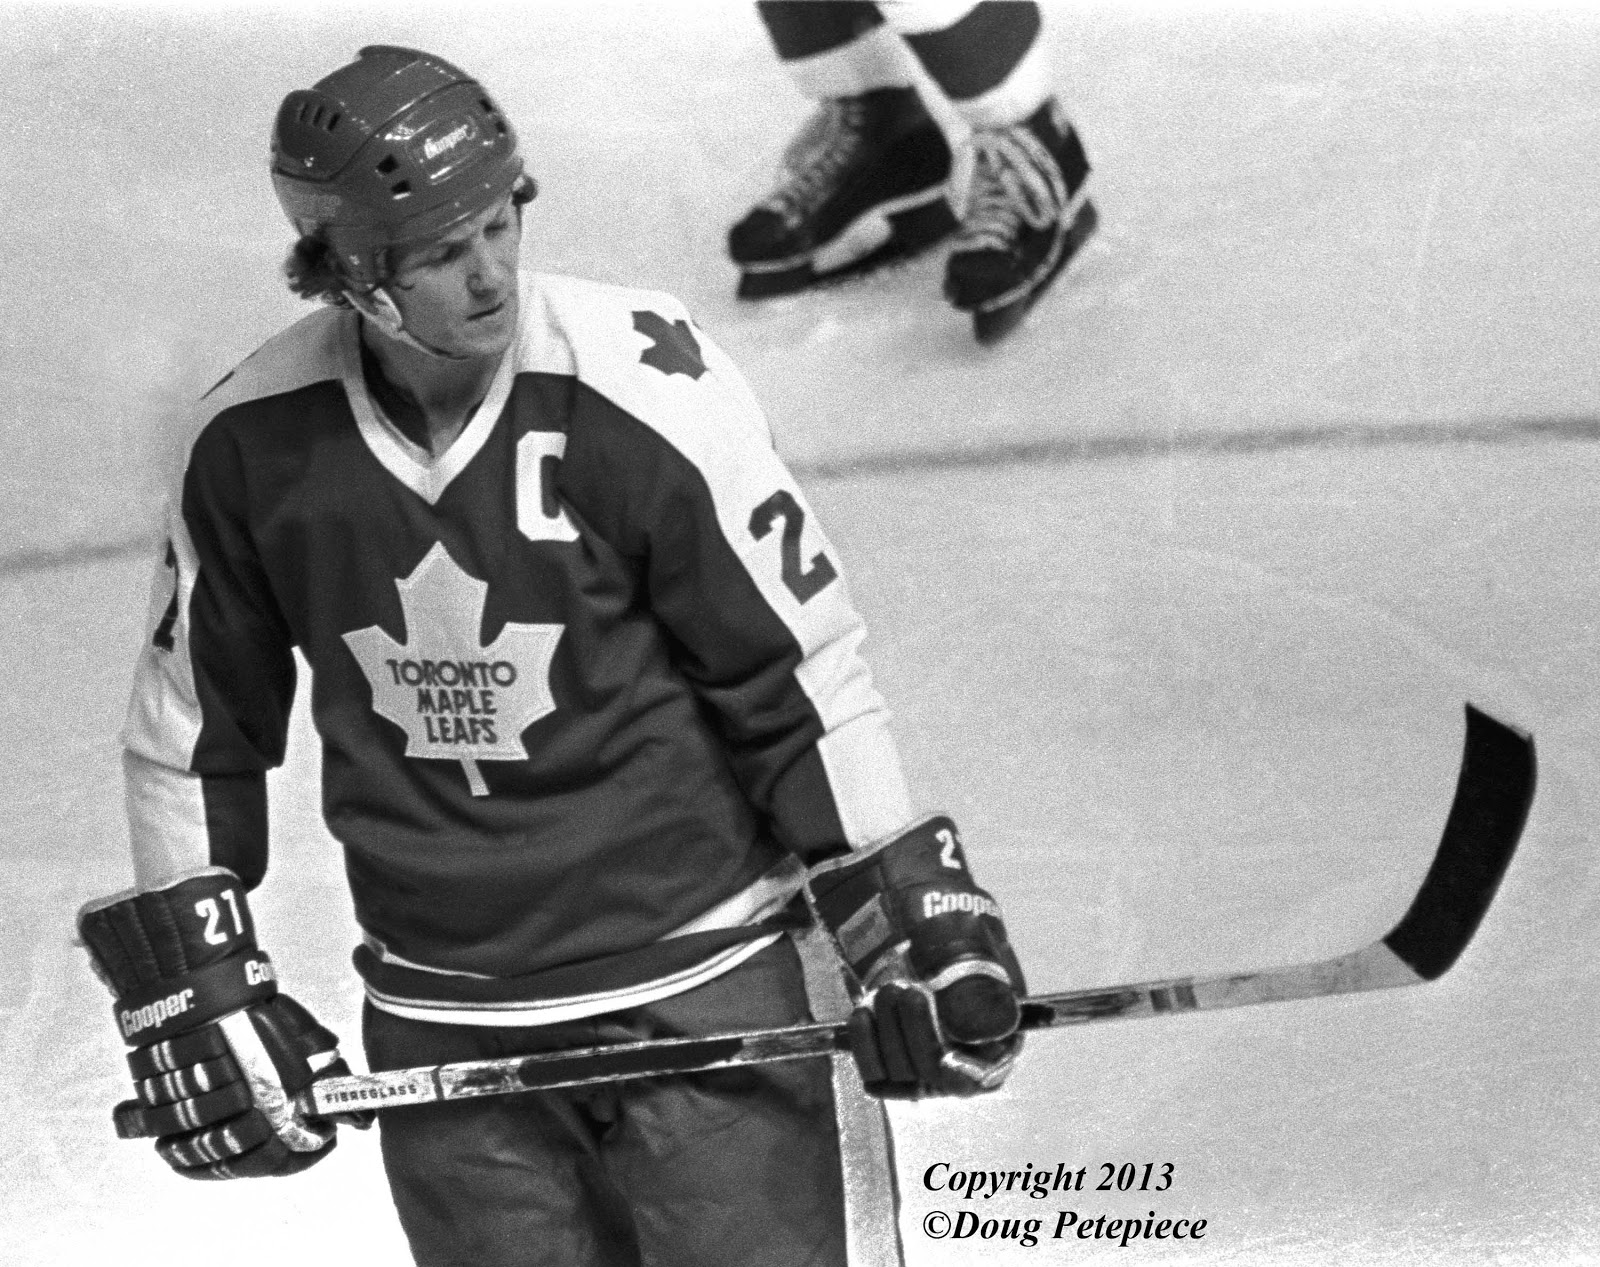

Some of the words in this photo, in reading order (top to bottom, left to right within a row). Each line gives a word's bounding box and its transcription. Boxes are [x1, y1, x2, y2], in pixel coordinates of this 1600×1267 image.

[516, 430, 580, 542] C
[747, 489, 838, 606] 2
[386, 659, 517, 688] TORONTO
[417, 688, 497, 715] MAPLE
[424, 716, 498, 745] LEAFS
[195, 888, 244, 945] 21
[325, 1084, 417, 1104] FIBREGLASS
